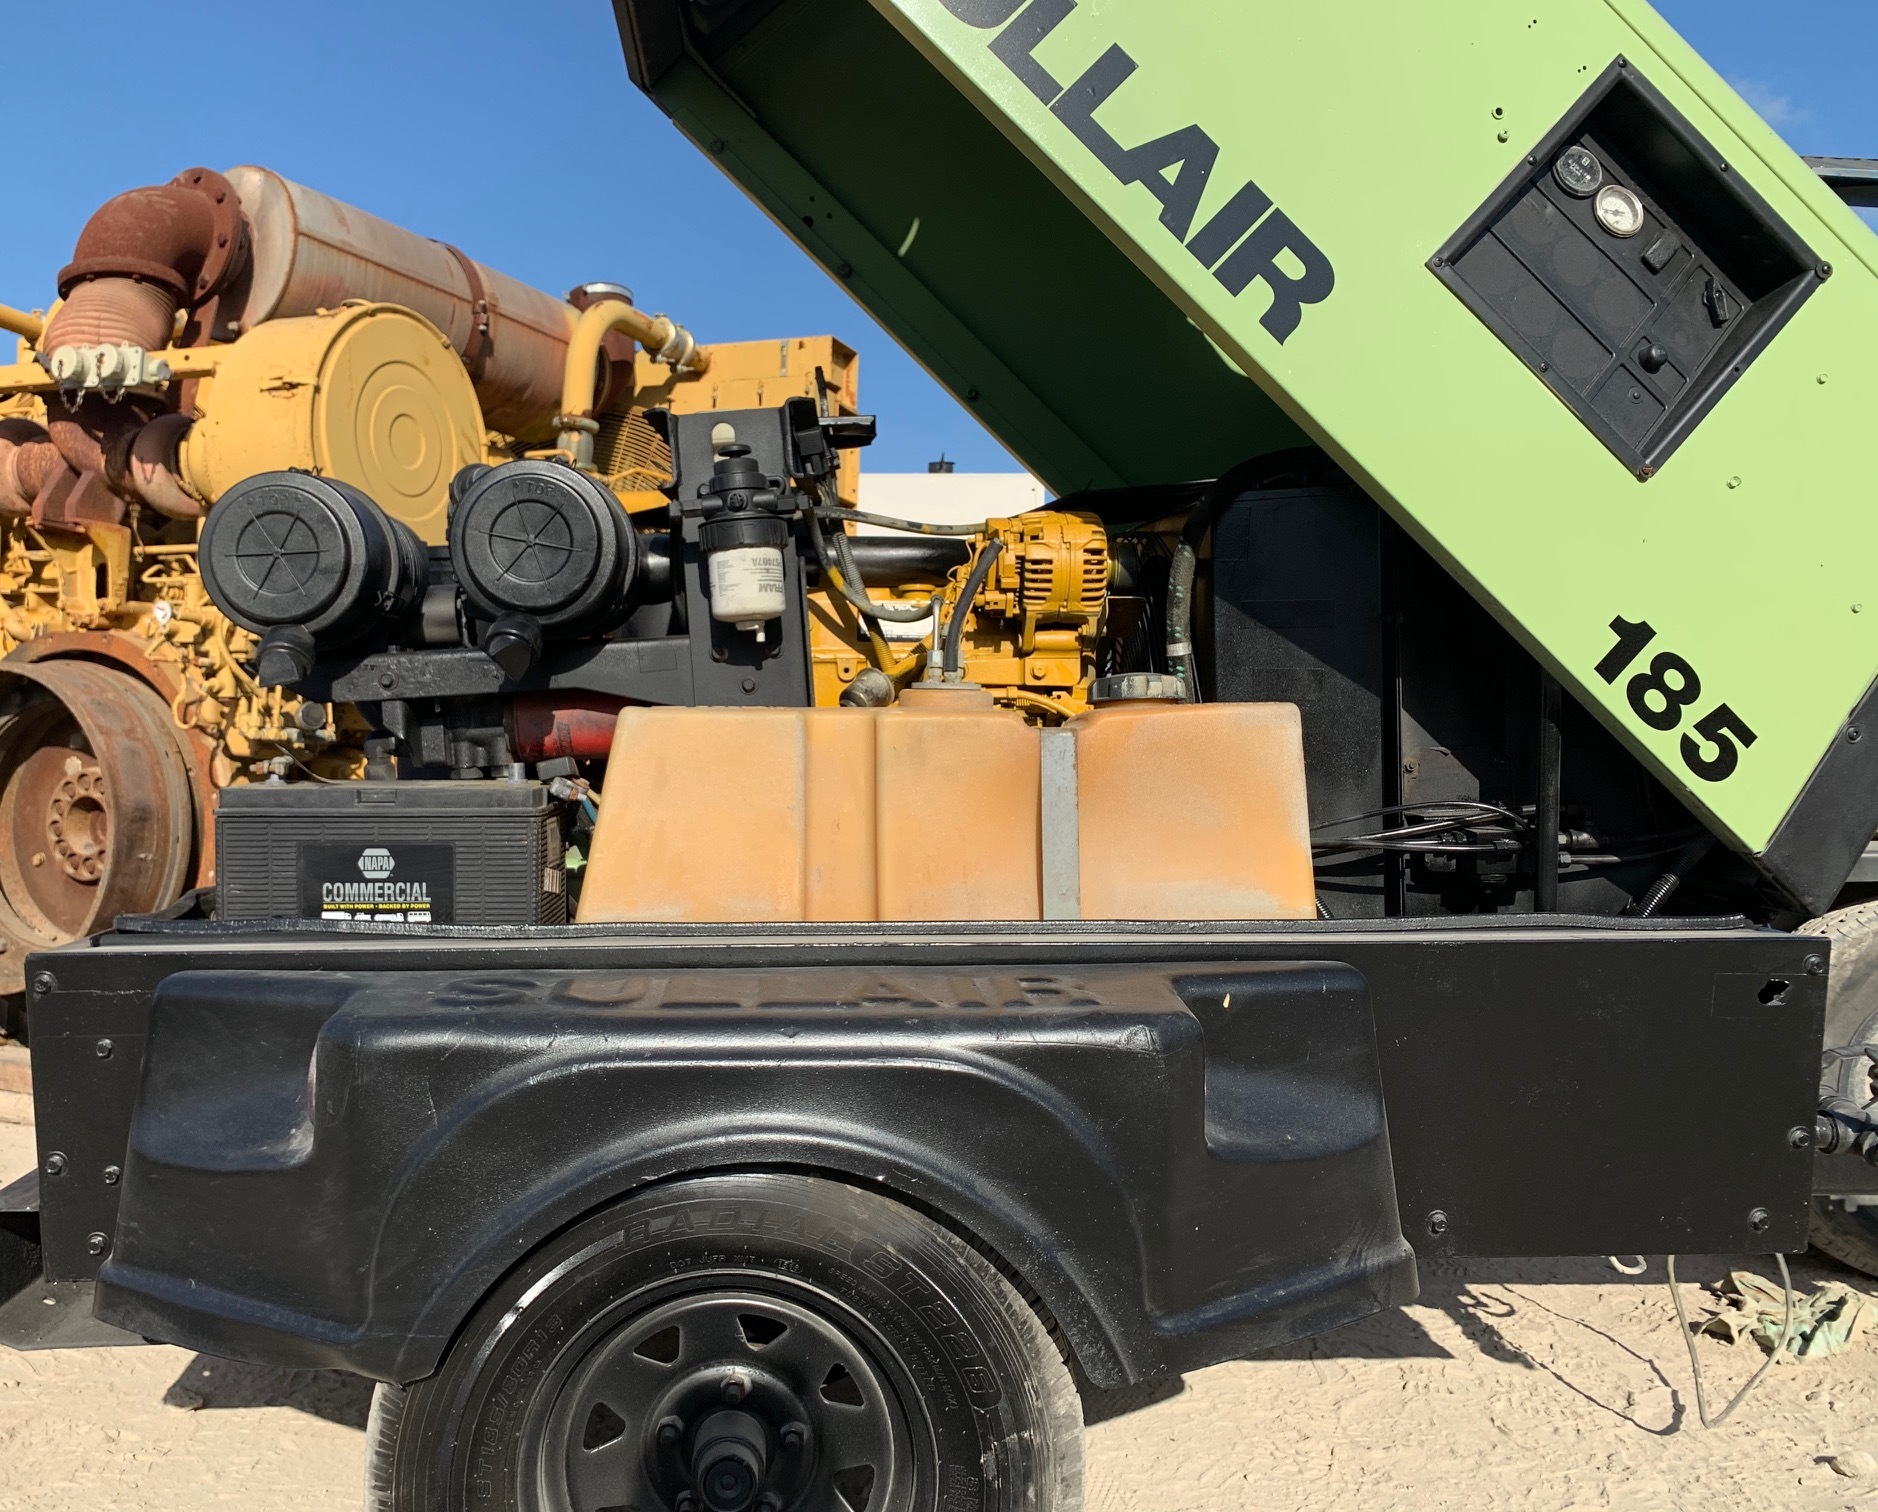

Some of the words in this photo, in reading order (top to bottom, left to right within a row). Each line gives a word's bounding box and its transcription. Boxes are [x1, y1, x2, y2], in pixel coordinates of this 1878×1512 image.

[937, 0, 1335, 347] LLAIR
[758, 583, 784, 593] FRAM
[1593, 614, 1758, 782] 185
[364, 856, 390, 871] NAPA
[322, 882, 432, 902] COMMERCIAL
[446, 974, 1101, 1009] SULLAIR
[622, 1205, 841, 1252] RADIAL
[669, 1258, 692, 1271] DOT
[861, 1251, 997, 1394] ST226
[476, 1313, 562, 1498] ST185/80R13
